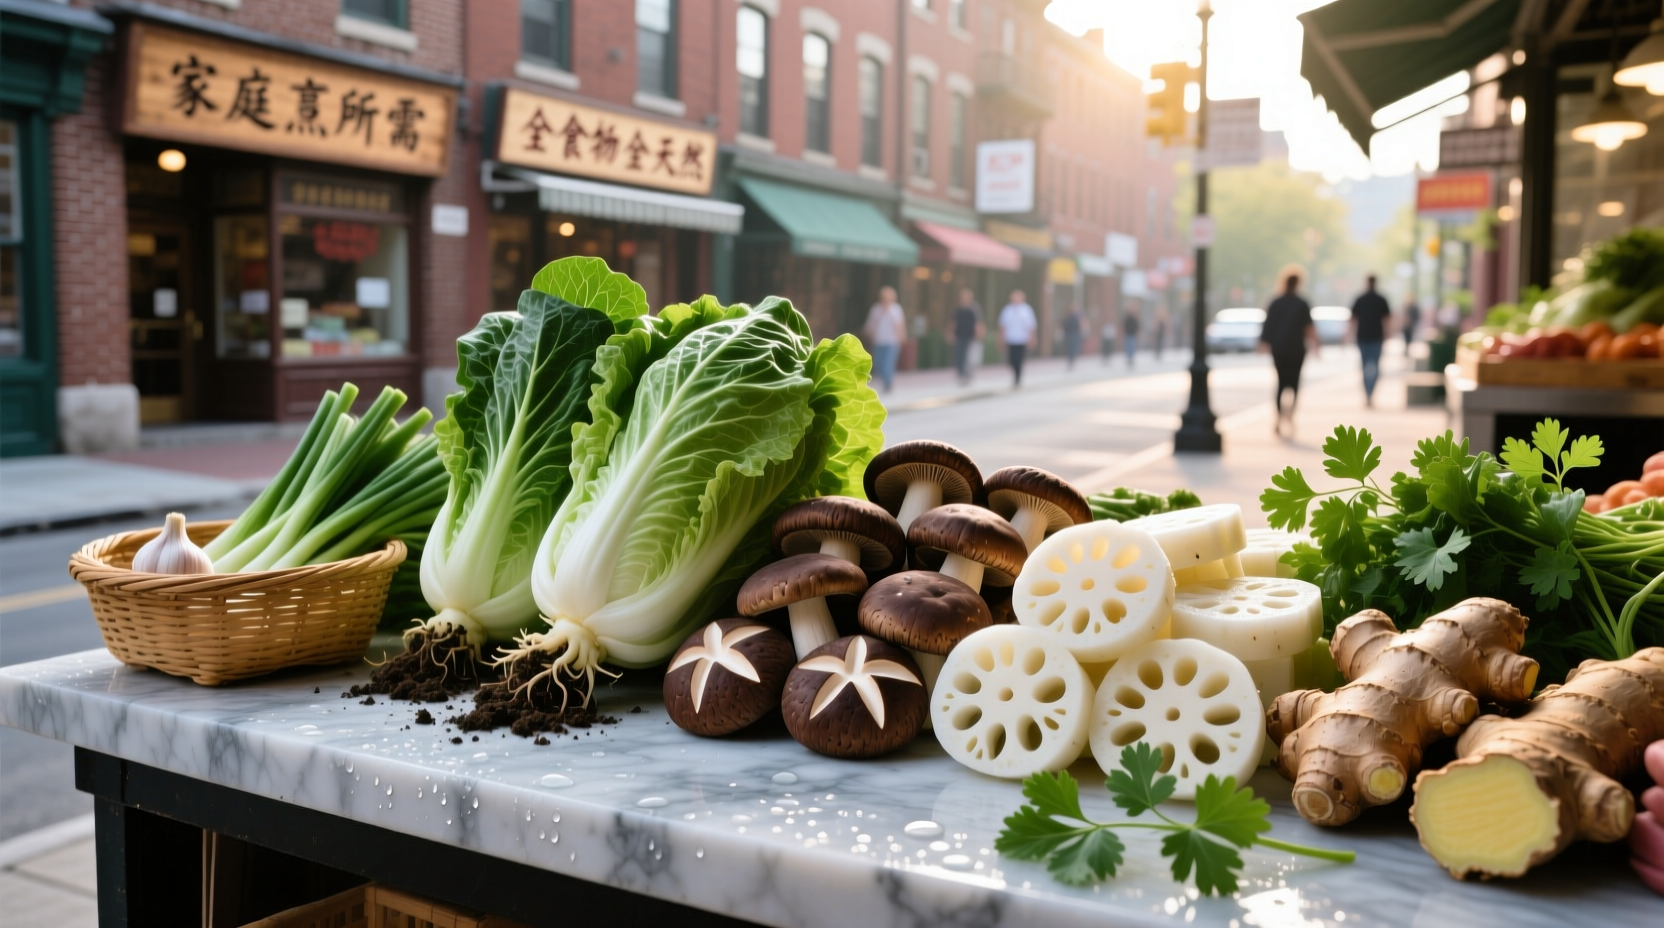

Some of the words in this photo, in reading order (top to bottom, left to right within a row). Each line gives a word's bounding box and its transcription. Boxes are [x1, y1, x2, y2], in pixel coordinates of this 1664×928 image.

[171, 55, 425, 151] 家庭烹所需
[522, 106, 704, 181] 全食物全天然
